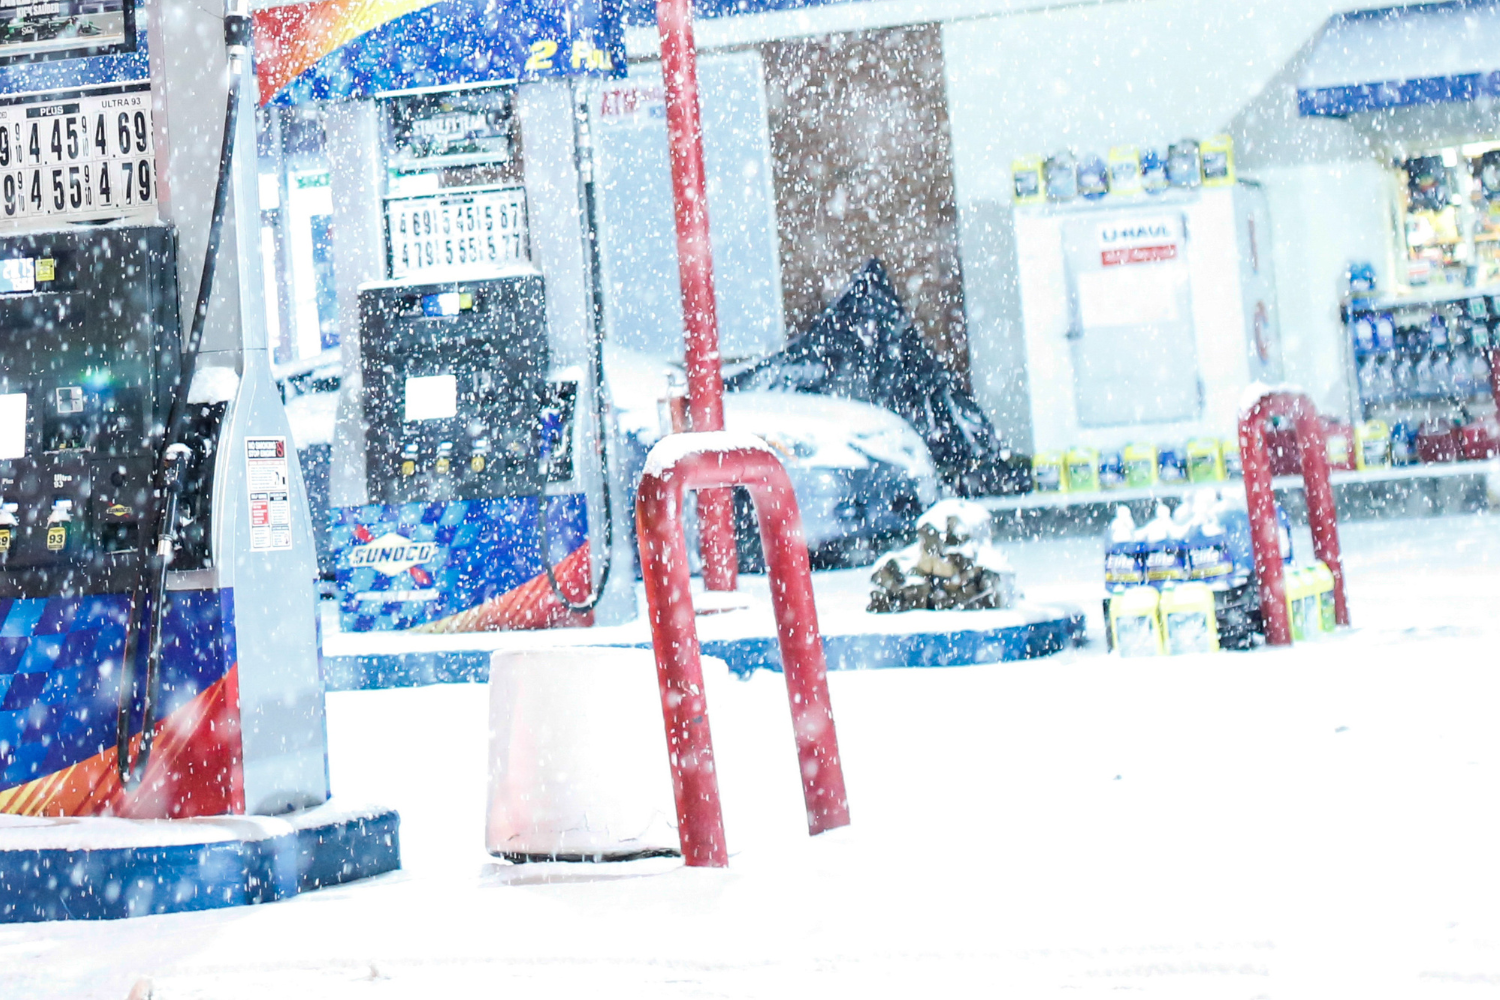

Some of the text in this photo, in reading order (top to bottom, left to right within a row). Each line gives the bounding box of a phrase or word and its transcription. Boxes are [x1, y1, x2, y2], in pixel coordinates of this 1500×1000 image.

[524, 40, 558, 70] 2
[101, 97, 141, 108] ULTRA 93
[40, 106, 64, 116] PLUS
[54, 474, 72, 482] Ultra
[54, 481, 64, 489] 93
[48, 534, 63, 544] 93
[353, 545, 431, 564] SUNOCO
